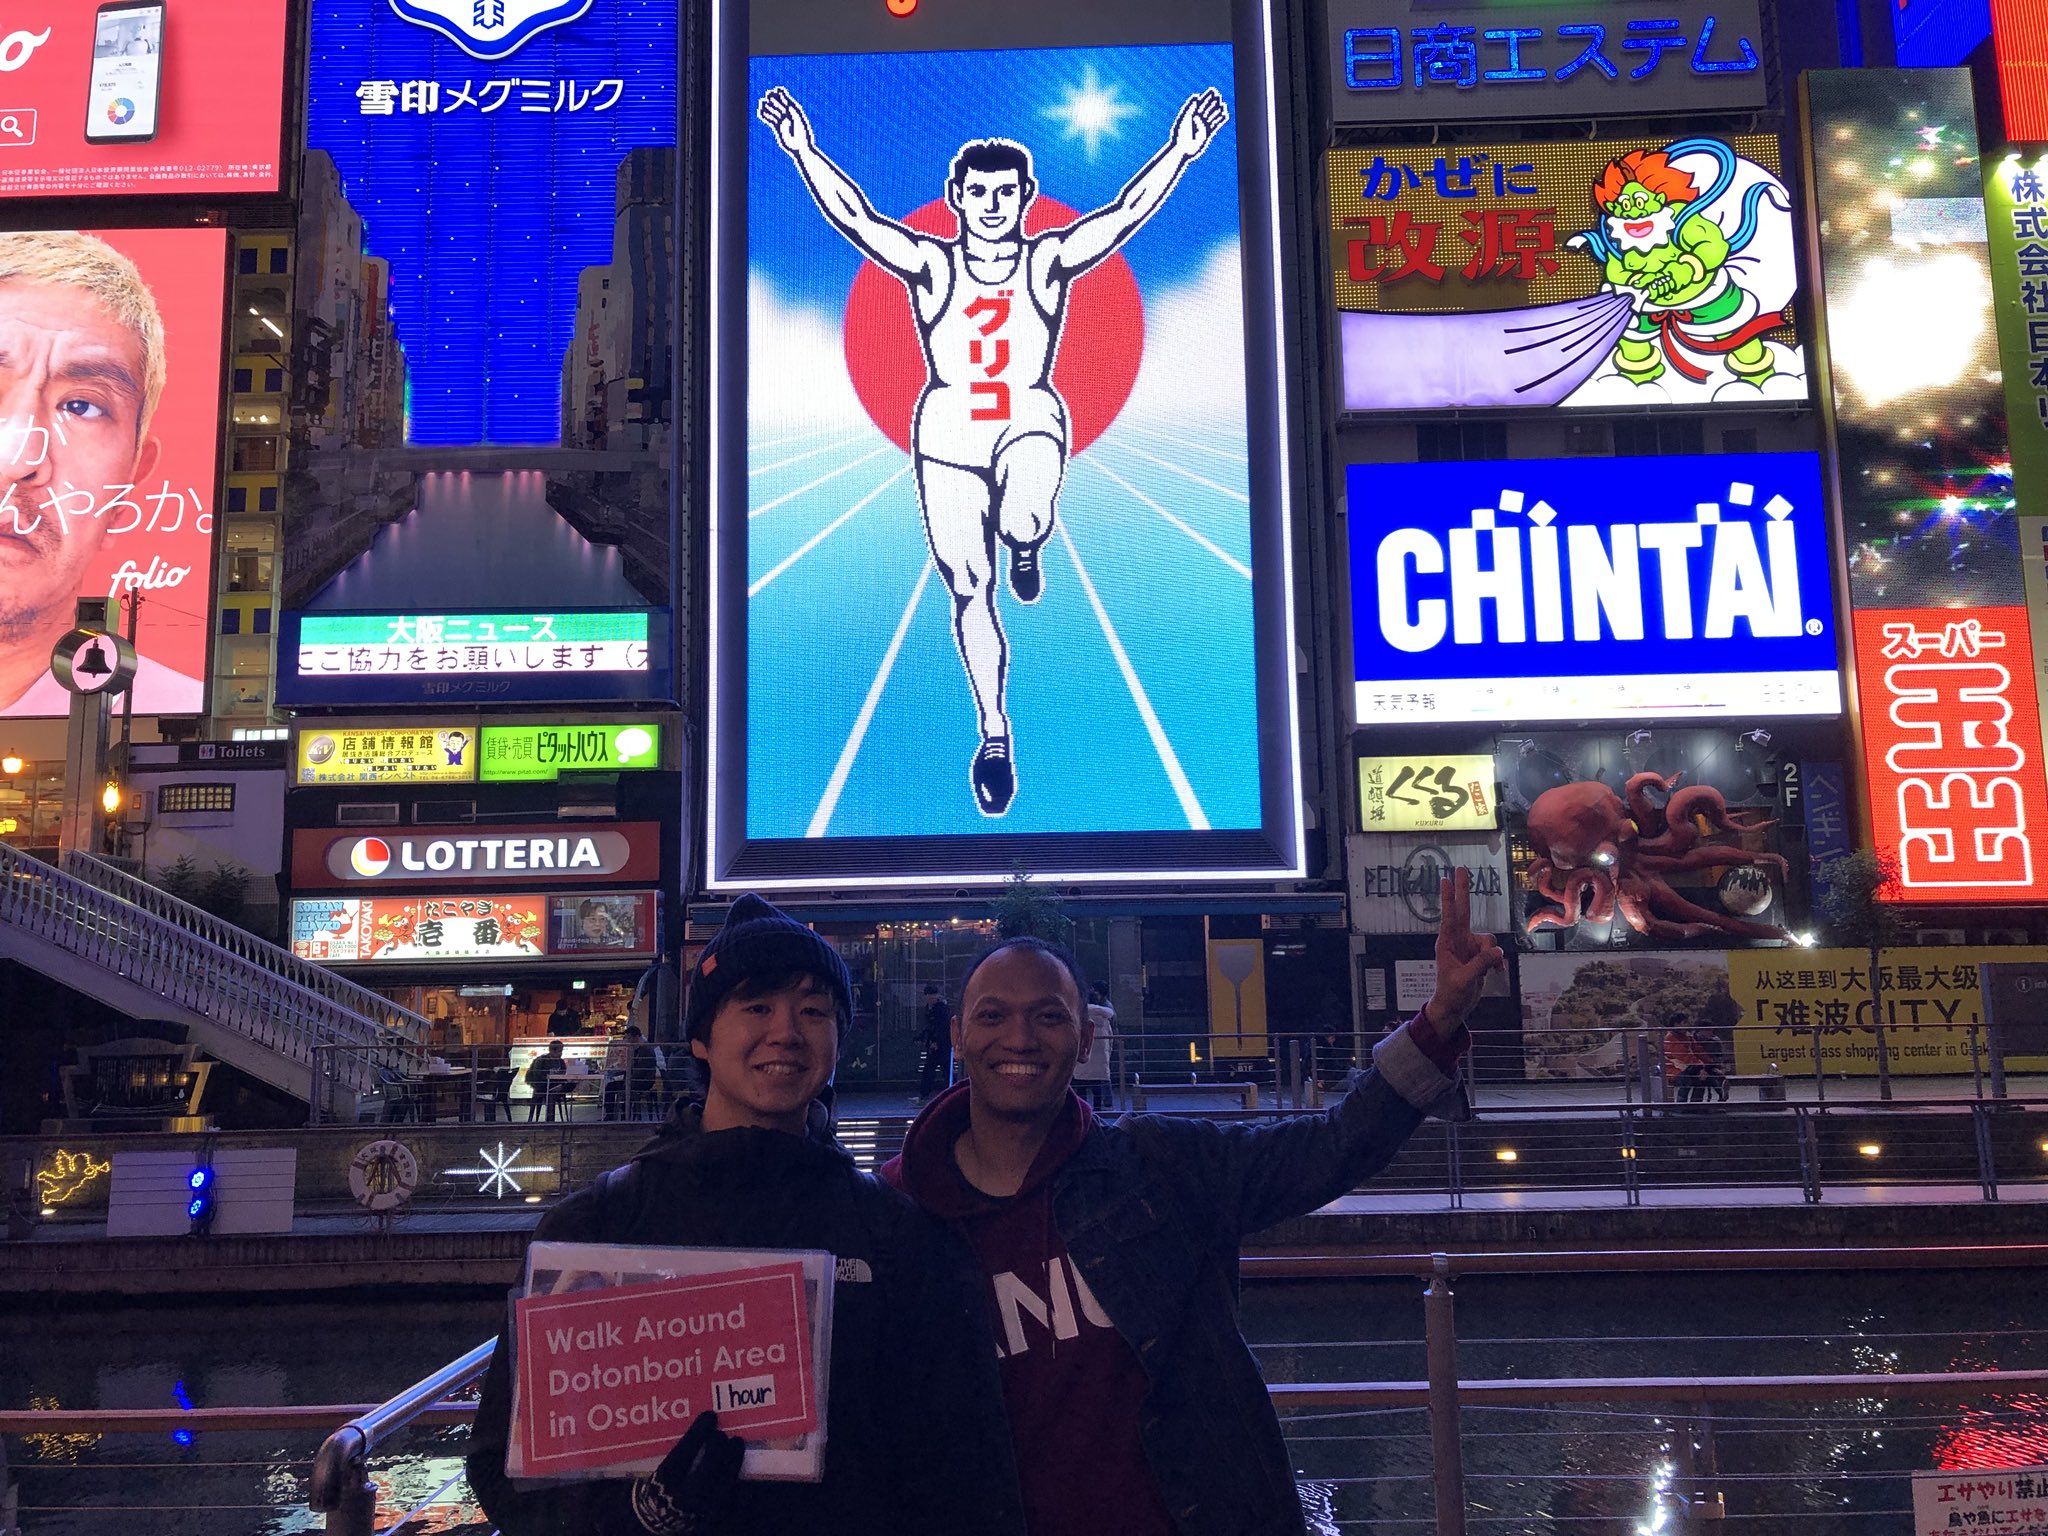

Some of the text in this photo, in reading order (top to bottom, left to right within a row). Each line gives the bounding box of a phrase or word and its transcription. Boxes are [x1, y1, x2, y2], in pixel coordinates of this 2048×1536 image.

[1344, 16, 1759, 88] 日商エステム
[355, 78, 624, 115] 雪印メグミルク
[1360, 154, 1538, 200] かぜに
[1343, 207, 1562, 283] 改源
[963, 290, 1014, 420] グリコ
[109, 555, 191, 598] folio
[1376, 481, 1804, 653] CHINTAI
[387, 615, 558, 644] 大阪ニュース
[1882, 619, 2006, 658] スーパー
[1372, 692, 1436, 712] 天気予報
[219, 744, 265, 758] Toilets
[343, 736, 434, 751] 店舗情報館
[537, 730, 608, 763] ピタットハウス
[319, 773, 355, 782] 株式会社
[359, 772, 416, 781] 関西インベスト
[1368, 765, 1386, 822] 道頓堀
[1385, 765, 1469, 819] くくる
[1784, 763, 1799, 807] 2F
[401, 837, 601, 871] LOTTERIA
[360, 901, 374, 958] TAKOYAKI
[424, 900, 494, 918] たこやき
[1760, 1044, 1806, 1061] Largest
[1810, 1044, 1841, 1058] cass
[1846, 1042, 1899, 1061] shoppng
[1904, 1043, 1941, 1057] center
[1945, 1041, 1957, 1056] in
[545, 1303, 746, 1354] Walk Around
[550, 1343, 786, 1397] Dotonbori Area
[730, 1385, 772, 1406] hour
[550, 1397, 690, 1438] in Osaka
